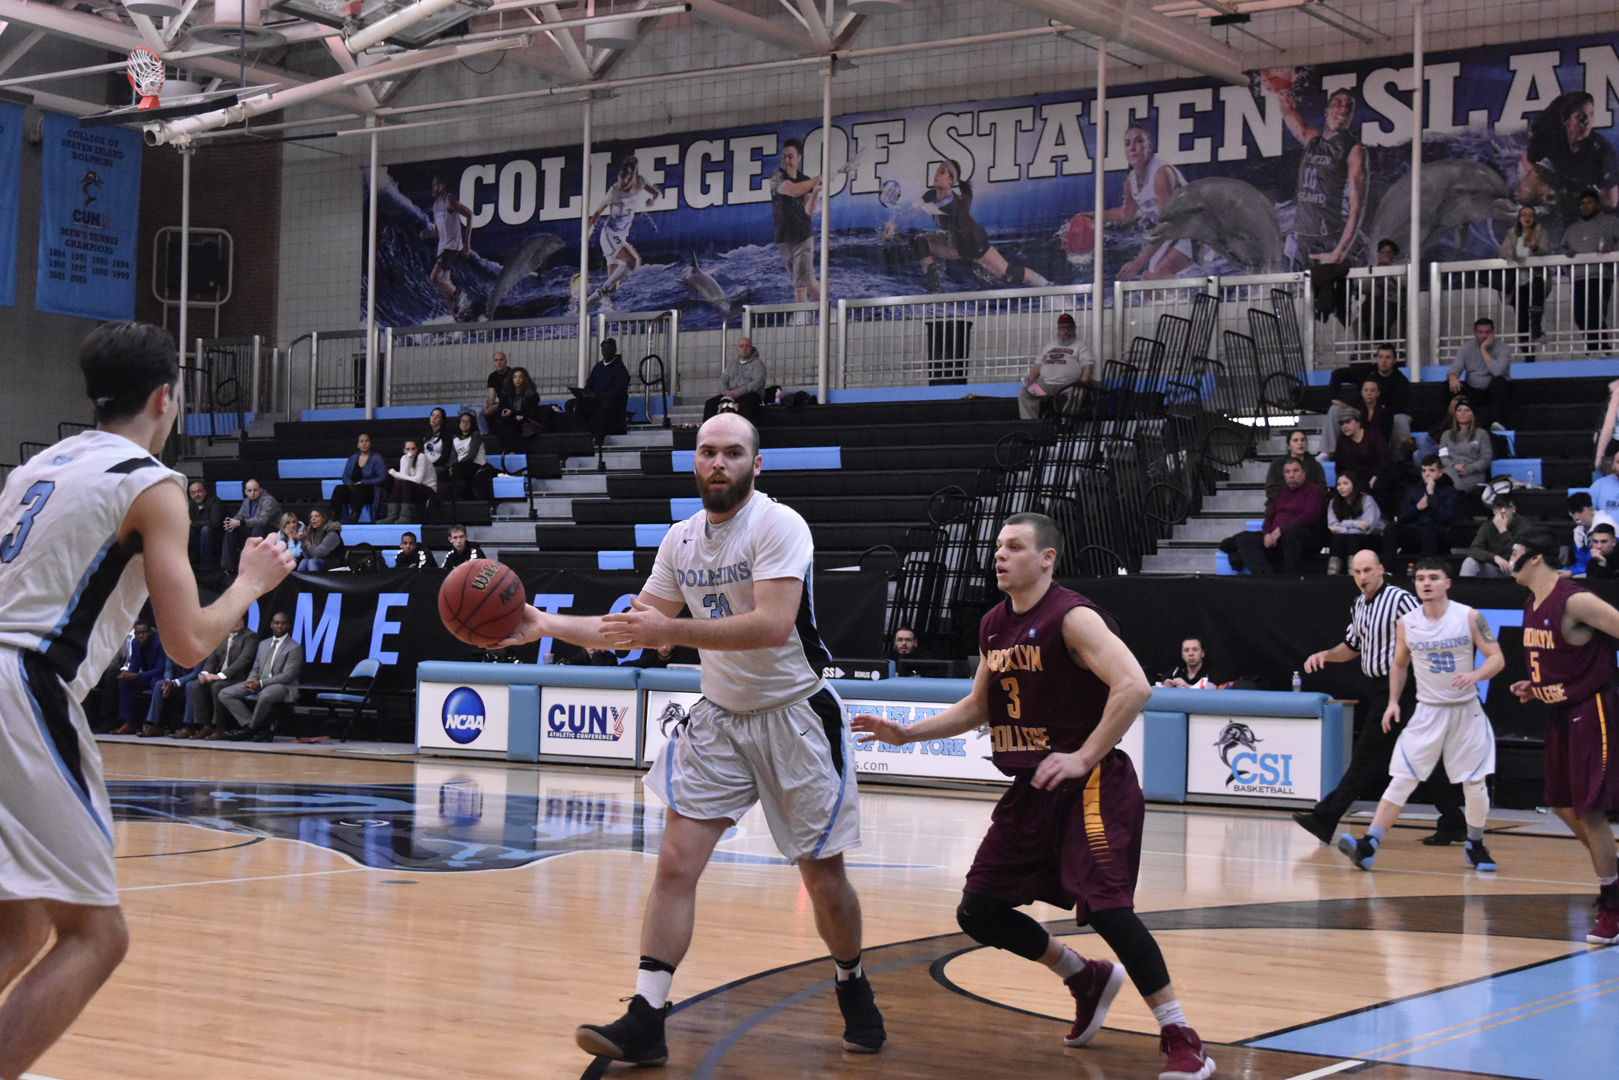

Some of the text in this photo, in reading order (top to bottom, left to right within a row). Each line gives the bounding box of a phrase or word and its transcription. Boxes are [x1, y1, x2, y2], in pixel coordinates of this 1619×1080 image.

[67, 129, 106, 145] COLLEGE
[459, 133, 778, 229] COLLEGE
[803, 118, 905, 198] OF
[926, 85, 1284, 188] STATEN
[0, 480, 55, 564] 3
[677, 561, 751, 588] DOLPHINS
[702, 592, 734, 619] 31
[1409, 635, 1470, 652] DOLPHINS
[1426, 651, 1456, 674] 30
[1529, 651, 1541, 683] 5
[1000, 677, 1021, 719] 3
[445, 714, 485, 731] NCAA
[547, 703, 629, 738] CUNY
[549, 731, 614, 741] ATHLETIC CONFERENCE
[853, 733, 875, 752] OF
[919, 739, 966, 757] YORK
[989, 725, 1051, 752] COLLEGE
[1231, 752, 1293, 787] CSI
[1233, 785, 1295, 795] BASKETBALL
